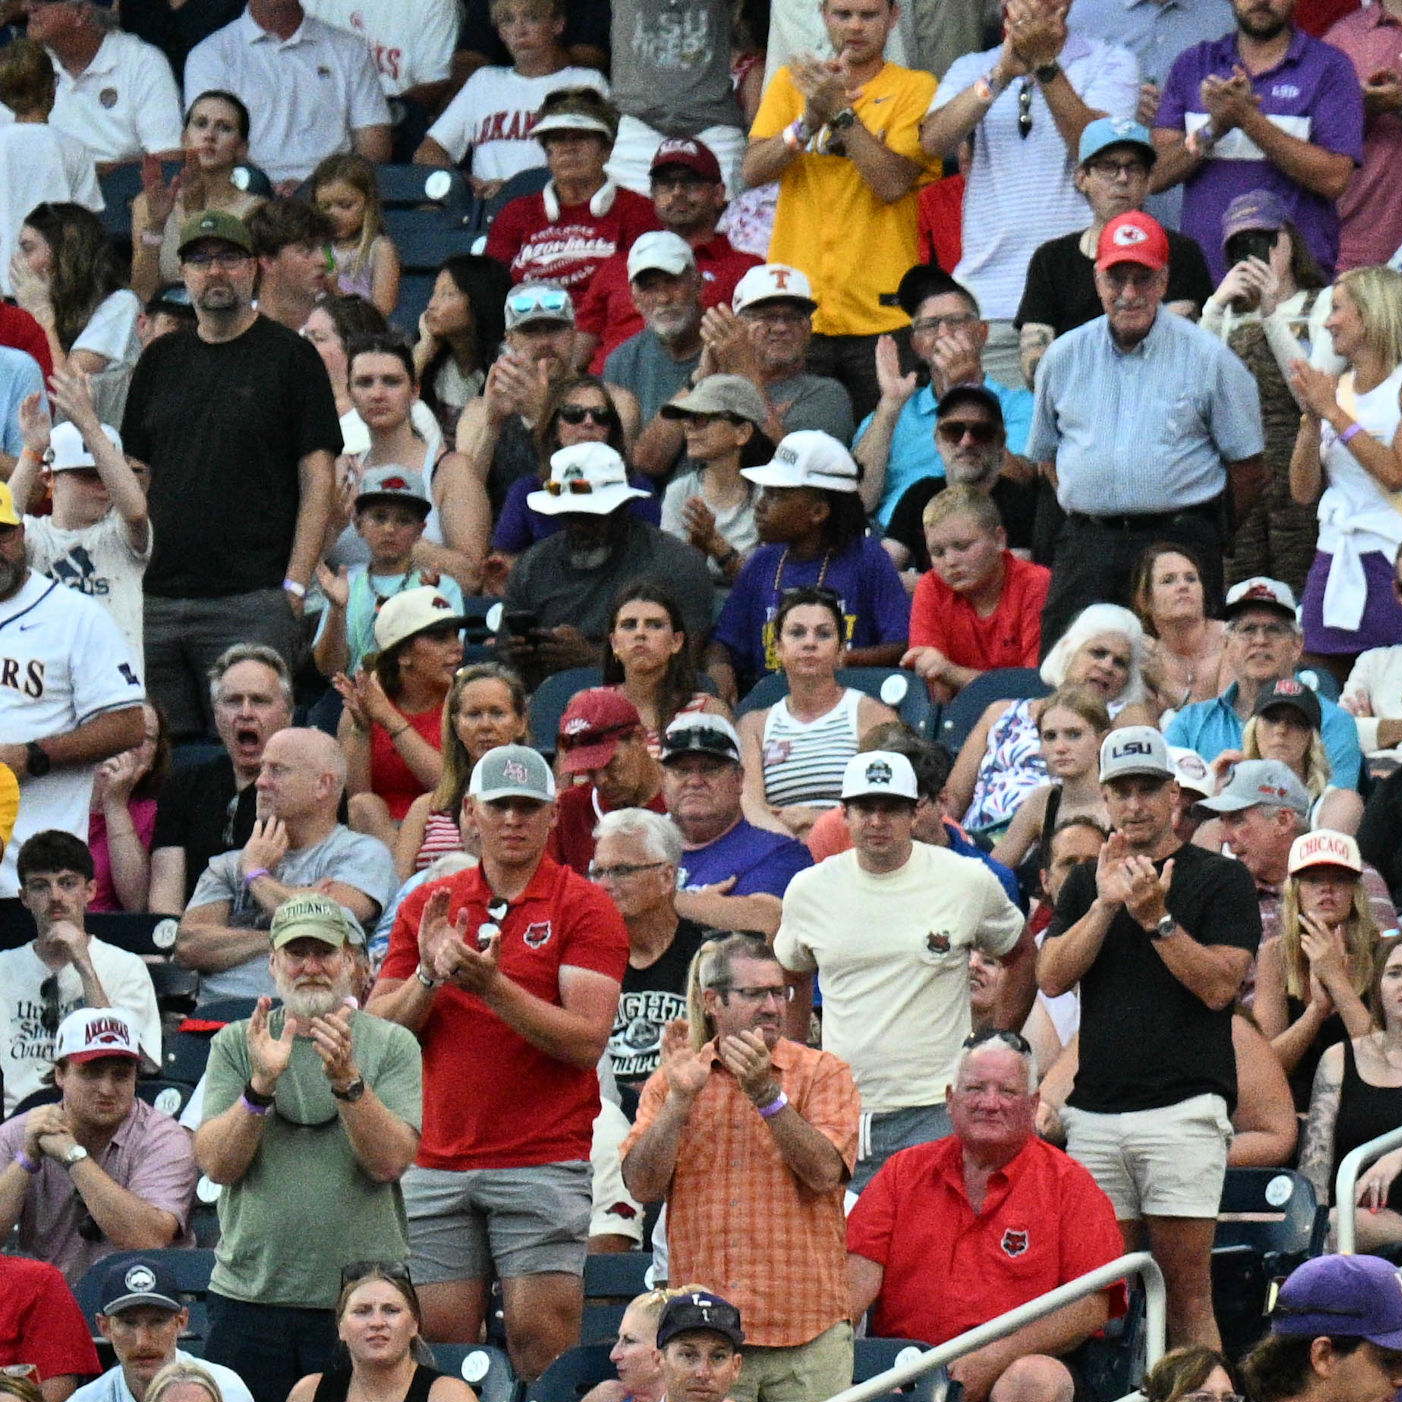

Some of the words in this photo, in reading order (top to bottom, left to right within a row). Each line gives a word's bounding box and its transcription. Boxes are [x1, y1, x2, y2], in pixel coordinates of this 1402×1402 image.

[765, 268, 790, 290] T
[1112, 741, 1153, 760] LSU
[1299, 835, 1351, 862] CHICAGO
[85, 1016, 131, 1047] ARKANSAS
